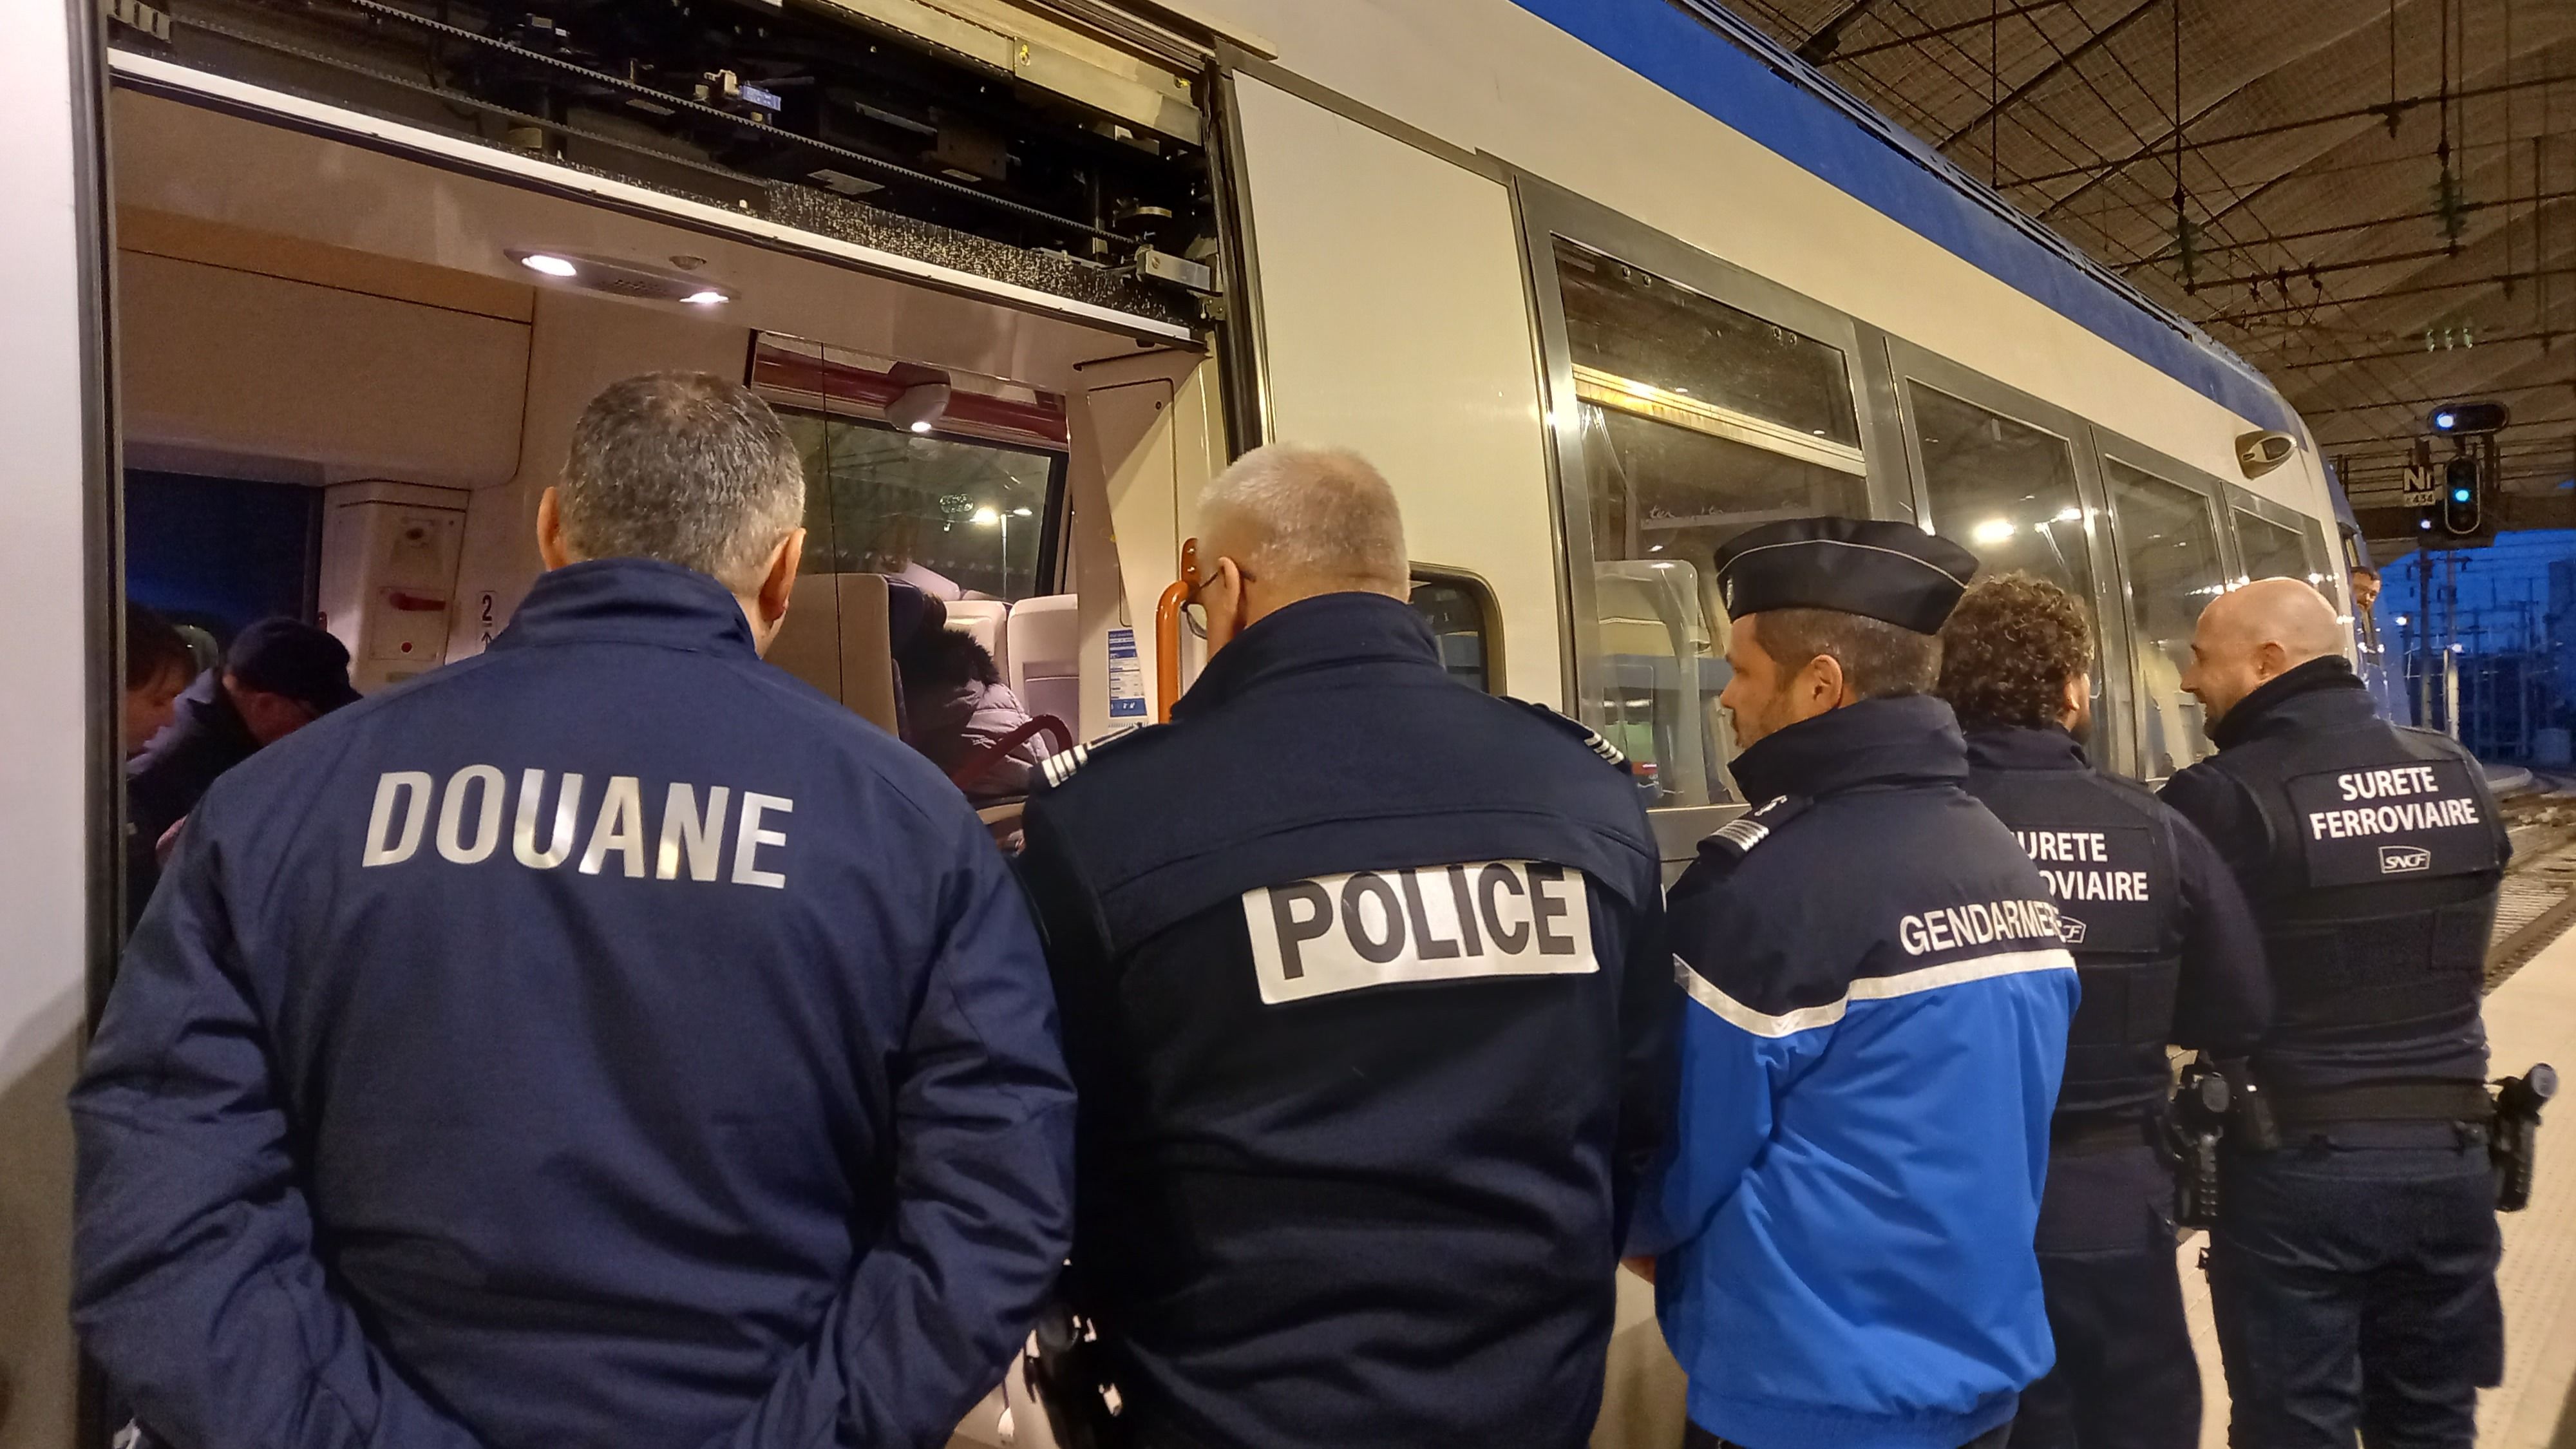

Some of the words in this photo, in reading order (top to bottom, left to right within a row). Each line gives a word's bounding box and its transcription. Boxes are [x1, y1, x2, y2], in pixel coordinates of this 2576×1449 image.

[482, 594, 493, 621] 2
[2338, 766, 2439, 801] SURETE
[362, 764, 793, 889] DOUANE
[2309, 798, 2479, 840] FERROVIAIRE
[2010, 831, 2108, 862] URETE
[2385, 853, 2427, 869] SNCF
[2039, 869, 2149, 901] OVIAIRE
[1267, 862, 1577, 980] POLICE
